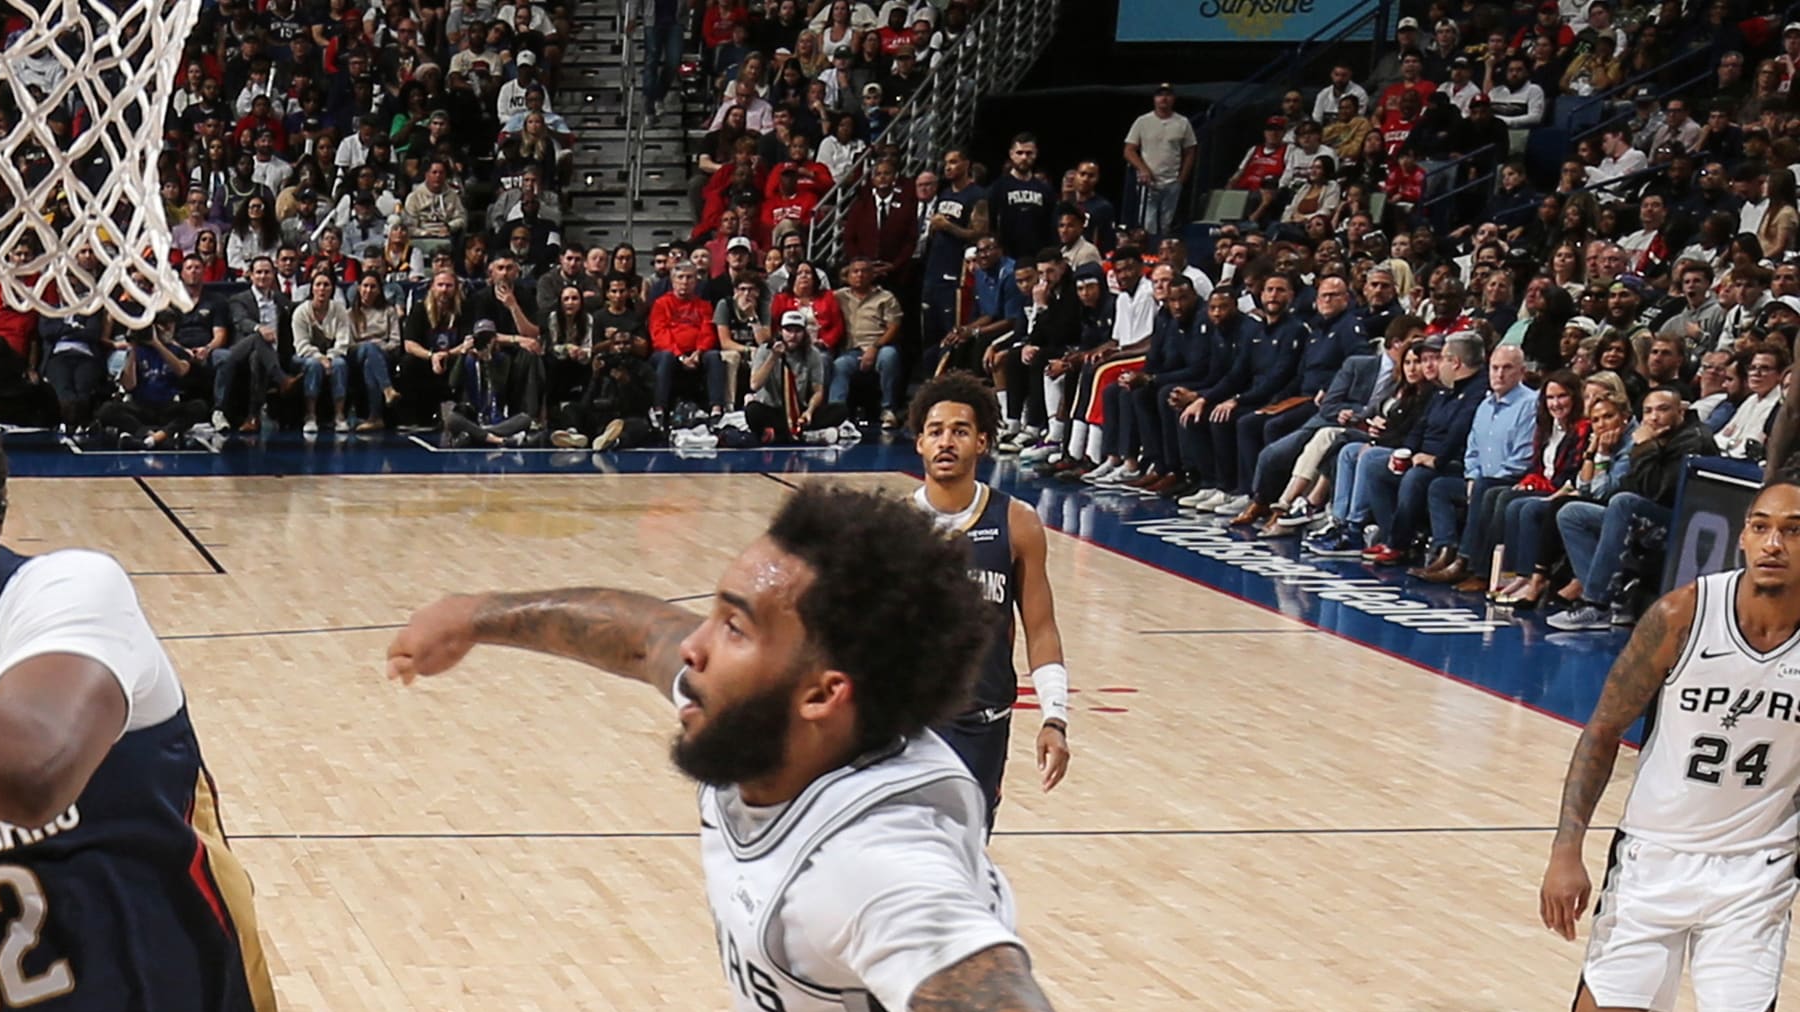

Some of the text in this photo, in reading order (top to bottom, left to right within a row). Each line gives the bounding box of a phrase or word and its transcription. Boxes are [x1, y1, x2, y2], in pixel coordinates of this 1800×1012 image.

[1135, 525, 1511, 633] Ochsner Health
[1684, 733, 1775, 789] 24
